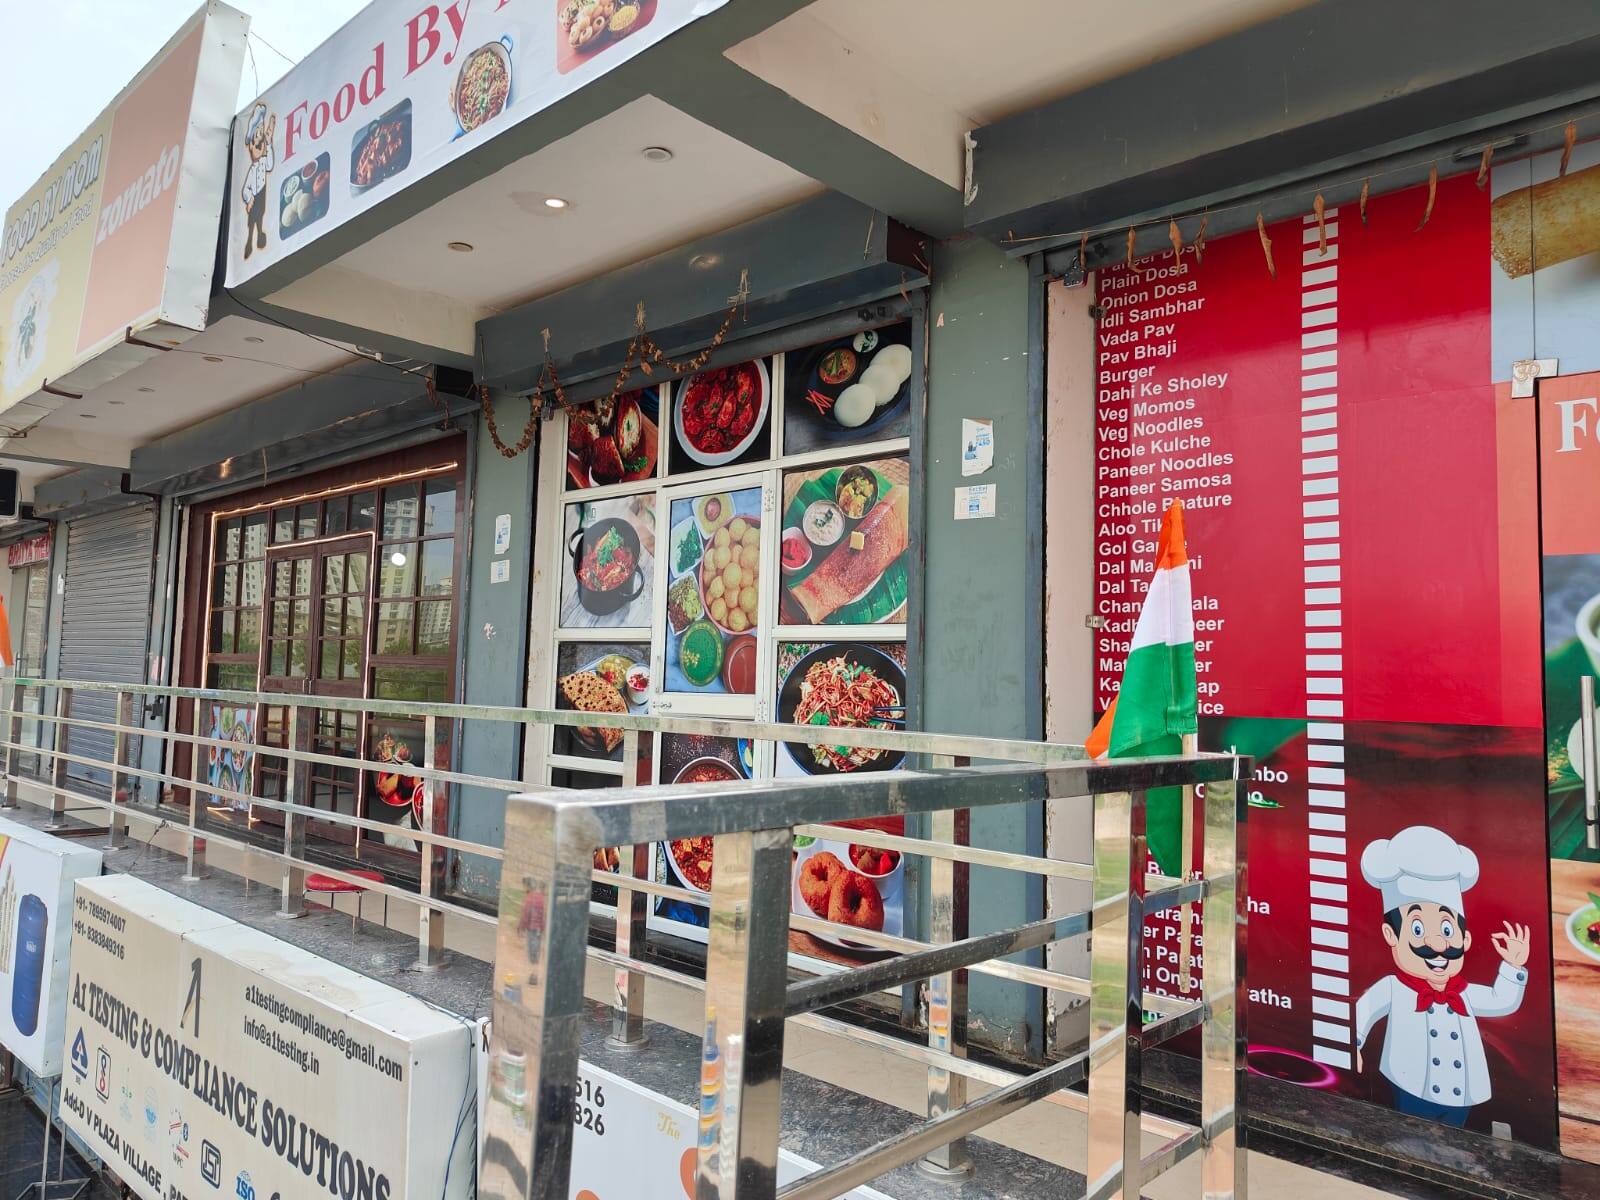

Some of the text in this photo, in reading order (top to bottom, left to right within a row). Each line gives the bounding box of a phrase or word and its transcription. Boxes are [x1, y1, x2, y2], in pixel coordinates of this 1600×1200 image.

[282, 0, 471, 161] Food By
[40, 175, 62, 232] BY
[59, 133, 104, 214] MOM
[96, 143, 182, 246] zomato
[1101, 263, 1188, 292] Plain Dosa
[1101, 280, 1197, 309] Onion Dosa
[1100, 297, 1205, 329] Idli Sambhar
[1100, 323, 1175, 347] Vada Pav
[1100, 340, 1177, 366] Pav Bhaji
[1100, 365, 1156, 385] Burger
[1100, 372, 1228, 403] Dahi Ke Sholey
[1099, 398, 1195, 422] Veg Momos
[1098, 415, 1204, 443] Veg Noodles
[1098, 434, 1211, 461] Chole Kulche
[1099, 452, 1234, 480] Paneer Noodles
[1099, 473, 1232, 499] Paneer Samosa
[1098, 500, 1157, 518] Chhole
[1098, 522, 1136, 537] Aloo
[1099, 541, 1127, 556] Gol
[1099, 560, 1125, 575] Dal
[1099, 580, 1125, 595] Dal
[1099, 599, 1144, 614] Chan
[1197, 699, 1225, 715] ice
[244, 1015, 320, 1075] info@a1testing.in
[245, 985, 403, 1082] a1testingcompliance@gmail.com
[88, 982, 138, 1050] TESTING
[140, 1017, 152, 1059] &
[153, 1028, 258, 1138] COMPLIANCE
[261, 1099, 391, 1200] SOLUTIONS
[86, 1106, 93, 1126] V
[93, 1114, 120, 1154] PLAZA
[122, 1140, 162, 1194] VILLAGE
